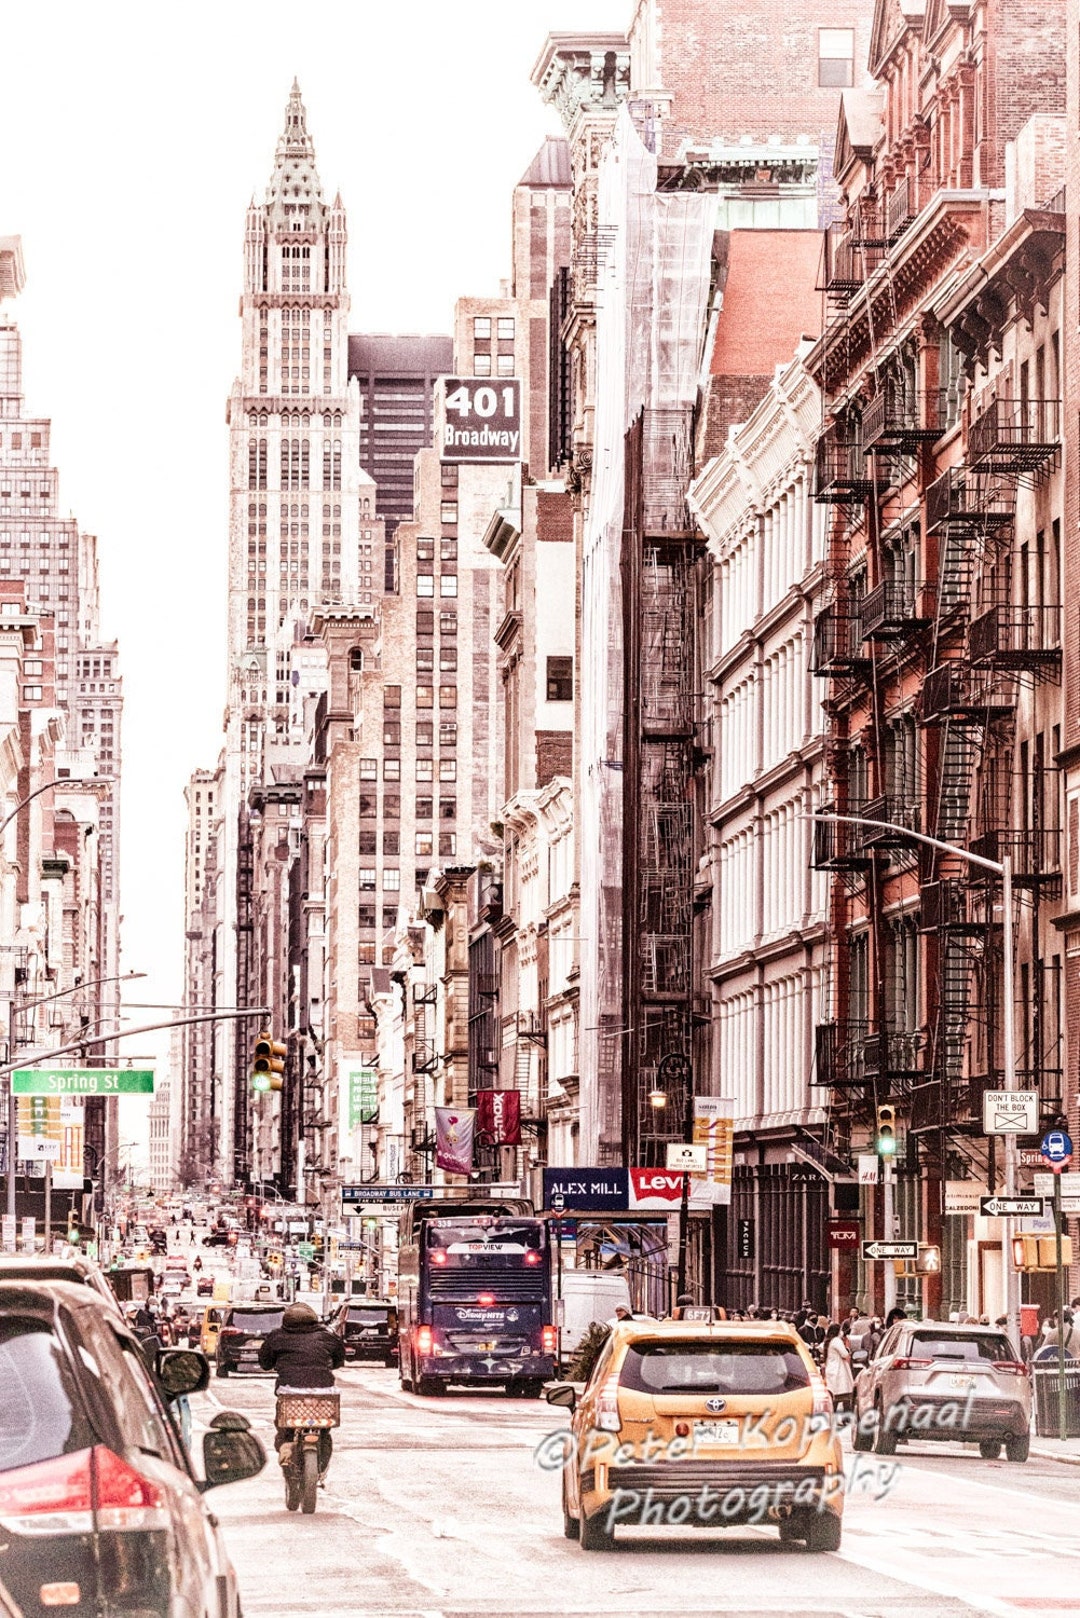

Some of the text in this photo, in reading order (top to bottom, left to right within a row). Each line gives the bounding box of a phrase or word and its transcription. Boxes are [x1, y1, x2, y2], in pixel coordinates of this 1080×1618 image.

[445, 386, 514, 417] 401
[445, 424, 519, 453] Broadway
[49, 1074, 119, 1093] Spring St
[988, 1094, 1034, 1102] DON'T BLOCK
[1021, 1151, 1043, 1165] Sprin
[792, 1173, 825, 1181] ZARA
[551, 1183, 622, 1194] ALEX MILL
[989, 1202, 1036, 1211] ONE WAY
